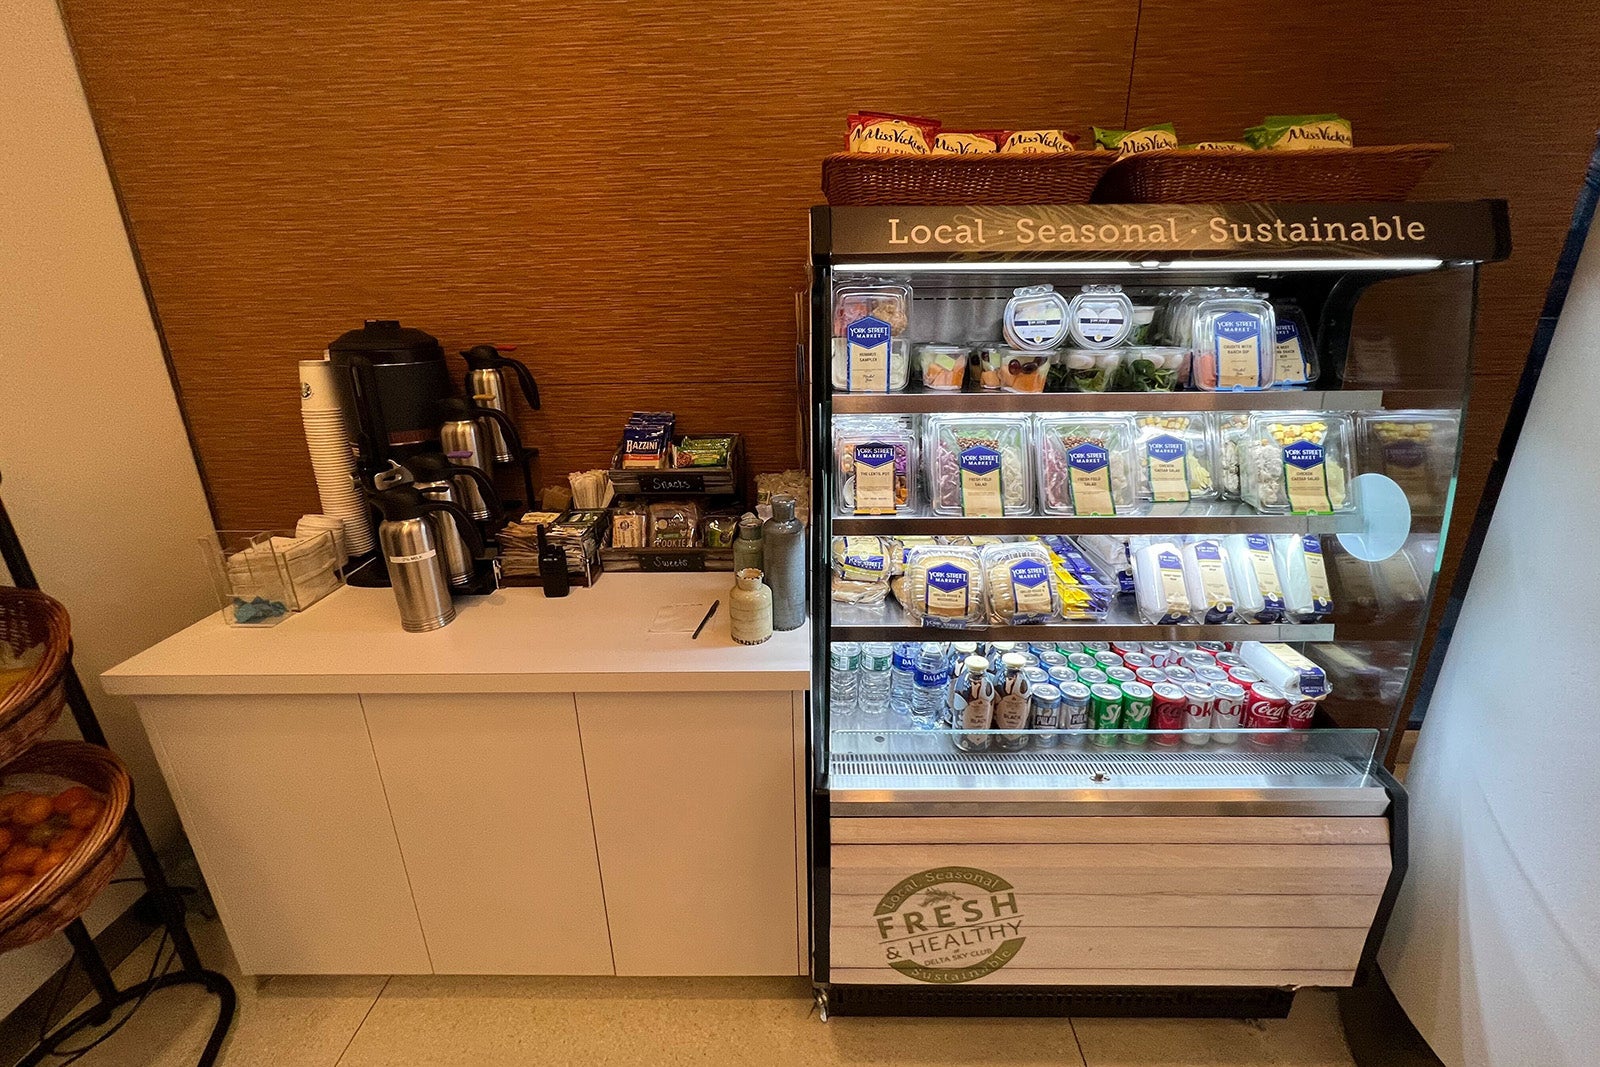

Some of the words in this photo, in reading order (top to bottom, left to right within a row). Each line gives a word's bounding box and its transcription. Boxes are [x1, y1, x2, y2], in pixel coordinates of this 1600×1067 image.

[888, 218, 986, 245] Local
[1016, 218, 1178, 244] Seasonal
[1208, 216, 1426, 244] Sustainable
[1217, 321, 1234, 330] YORK
[1236, 321, 1256, 330] STREET
[850, 327, 866, 336] YORK
[867, 327, 888, 336] STREET
[625, 440, 658, 453] BAZZINI
[1148, 443, 1164, 451] YORK
[1164, 443, 1183, 451] STREET
[857, 448, 873, 457] YORK
[873, 448, 893, 457] STREET
[1069, 453, 1086, 462] YORK
[1086, 452, 1106, 461] STREET
[1284, 449, 1301, 458] YORK
[1302, 449, 1322, 458] STREET
[961, 455, 977, 464] YORK
[979, 455, 999, 464] STREET
[652, 478, 691, 490] Snacks
[653, 556, 688, 568] Sweets
[929, 571, 946, 581] YORK
[946, 572, 966, 582] STREET
[1011, 568, 1028, 578] YORK
[1027, 567, 1047, 576] STREET
[925, 871, 1000, 889] Seasonal
[876, 892, 1018, 939] FRESH
[886, 946, 903, 960] &
[908, 919, 1022, 956] HEALTHY
[924, 956, 950, 967] DELTA
[952, 952, 968, 961] SKY
[970, 947, 993, 958] CLUB
[911, 949, 1012, 982] Sustainable
